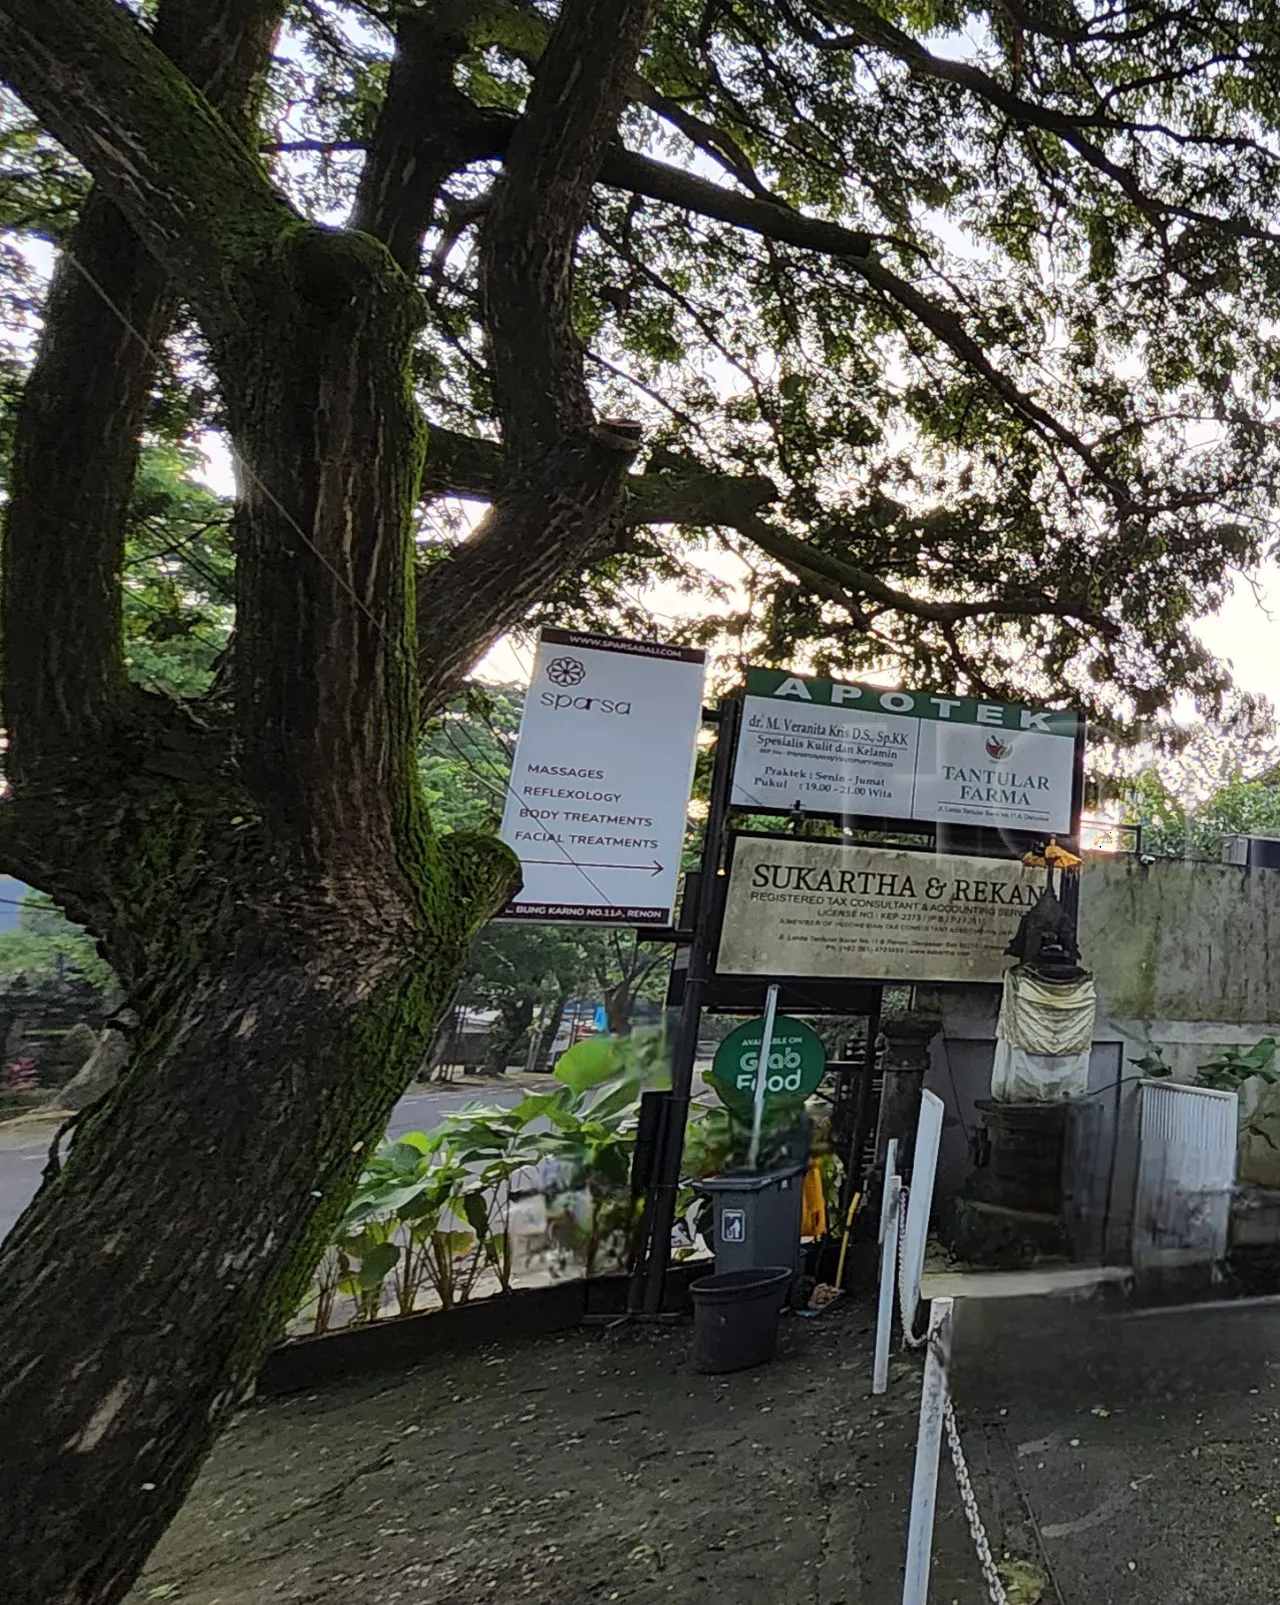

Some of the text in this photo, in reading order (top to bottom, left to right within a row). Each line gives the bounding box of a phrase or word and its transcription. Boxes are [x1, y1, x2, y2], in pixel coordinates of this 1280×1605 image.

[569, 635, 682, 658] WWW.SPARSABALI.COM
[540, 691, 632, 715] sparsa
[772, 676, 1053, 732] APOTEK
[749, 714, 763, 728] dr.
[783, 719, 826, 736] Veranita
[828, 724, 850, 739] Kris
[876, 731, 908, 747] Sp.KK
[757, 735, 804, 748] Spesialis
[806, 740, 833, 752] Kulit
[835, 743, 854, 754] dan
[856, 746, 898, 759] Kelamin
[527, 764, 604, 780] MASSAGES
[765, 766, 806, 778] Praktek
[815, 773, 845, 783] Senin
[854, 775, 885, 786] Jumat
[942, 765, 1050, 791] TANTULAR
[523, 786, 622, 803] REFLEXOLOGY
[753, 777, 788, 789] Pukul
[805, 782, 832, 792] 19.00
[839, 785, 866, 796] 21.00
[868, 788, 892, 798] Wita
[960, 785, 1031, 805] FARMA
[519, 808, 653, 827] BODY TREATMENTS
[514, 831, 659, 849] FACIAL TREATMENTS
[752, 864, 1045, 906] SUKARTHA & REKAN
[516, 905, 546, 914] BUNG
[548, 906, 585, 916] KARNO
[627, 909, 661, 918] RENON
[750, 891, 824, 905] REGISTERED
[827, 896, 848, 906] TAX
[850, 898, 919, 910] CONSULTANT
[929, 904, 996, 916] ACCOUNTING
[817, 909, 858, 918] LICENSE
[742, 1036, 803, 1046] AVAIBLE ON
[740, 1047, 801, 1072] Gab
